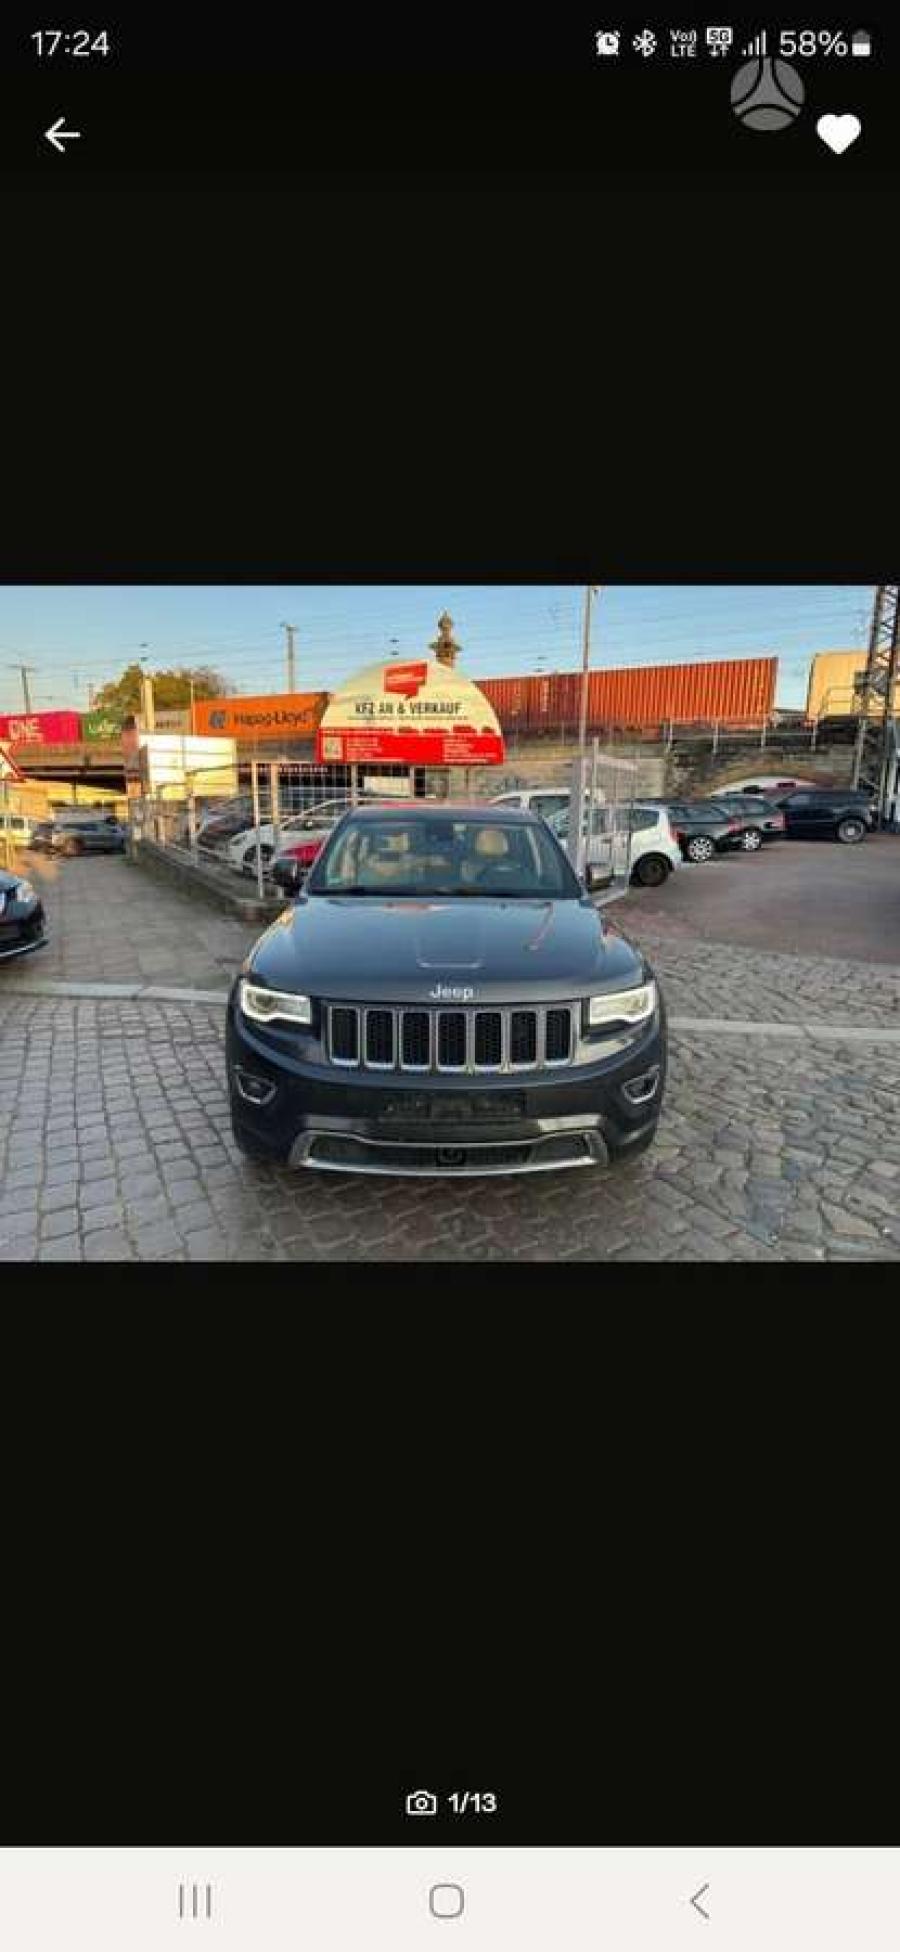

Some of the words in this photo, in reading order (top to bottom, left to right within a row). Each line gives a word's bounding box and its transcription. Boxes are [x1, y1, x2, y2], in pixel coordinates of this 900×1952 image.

[355, 702, 374, 714] KFZ
[379, 702, 393, 714] AN
[397, 702, 406, 714] &
[410, 702, 461, 714] VERKAUF
[234, 709, 308, 727] Hapag-Lloyd
[429, 983, 474, 1002] Jeep
